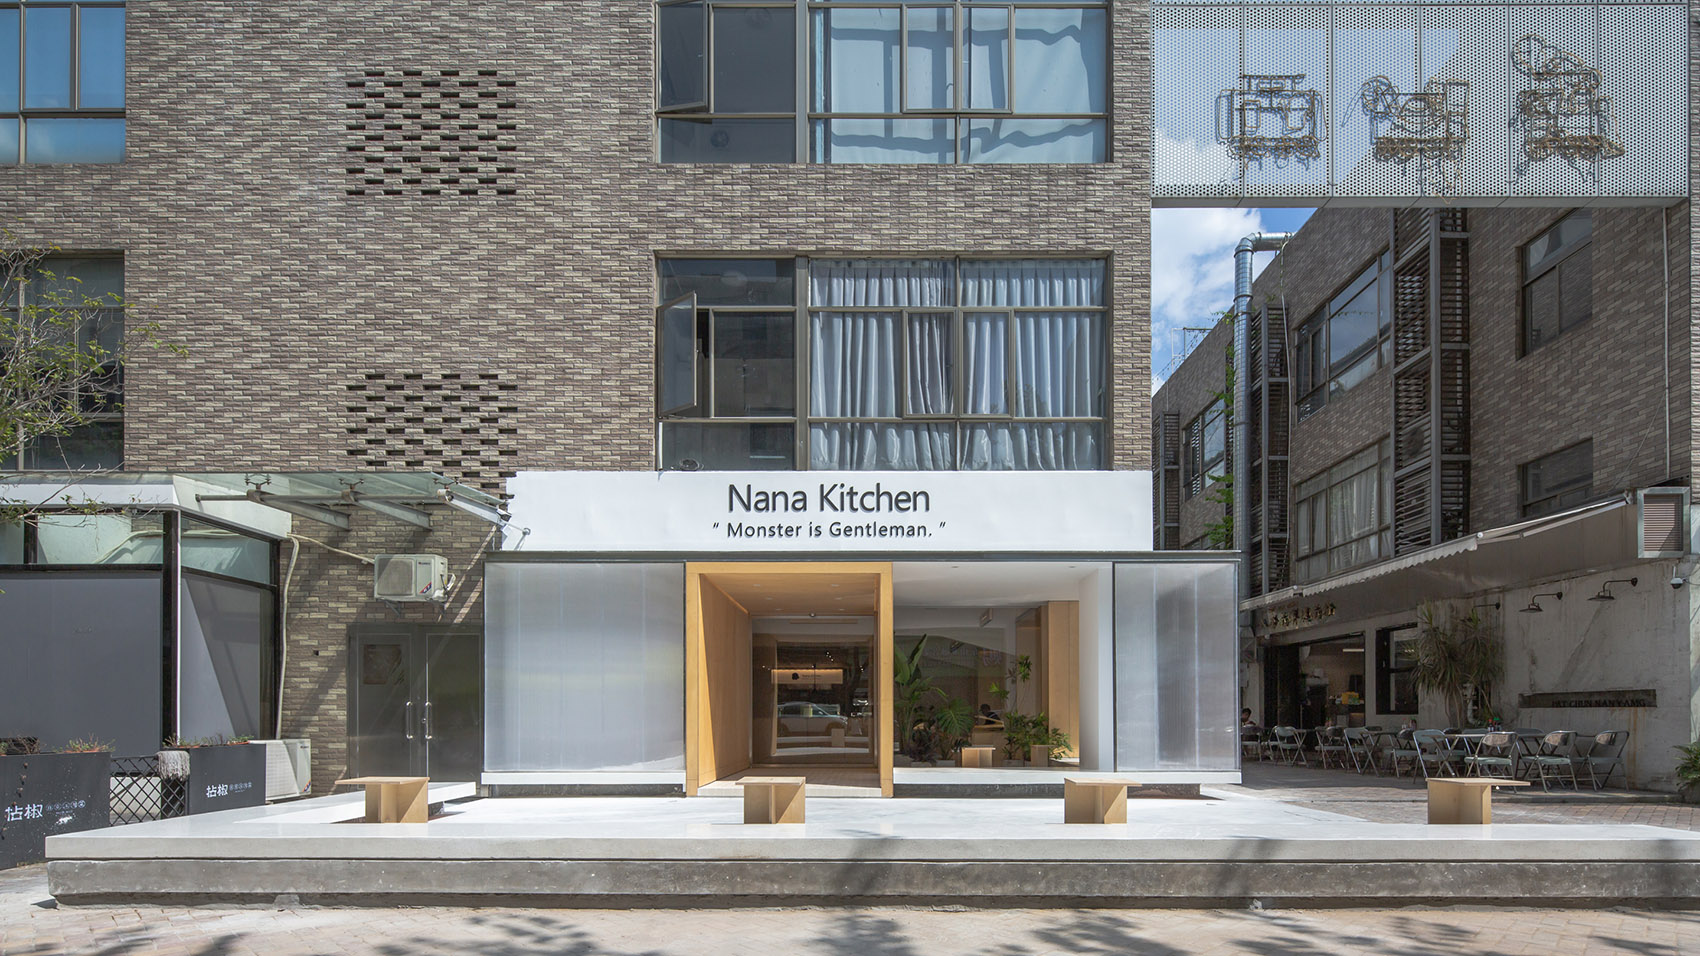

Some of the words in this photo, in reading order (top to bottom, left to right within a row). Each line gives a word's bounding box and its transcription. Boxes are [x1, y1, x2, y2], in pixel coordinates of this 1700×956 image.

[728, 484, 807, 512] Nana
[819, 483, 930, 512] Kitchen
[727, 523, 802, 538] Monster
[809, 522, 822, 537] is
[829, 522, 932, 538] Gentleman.
